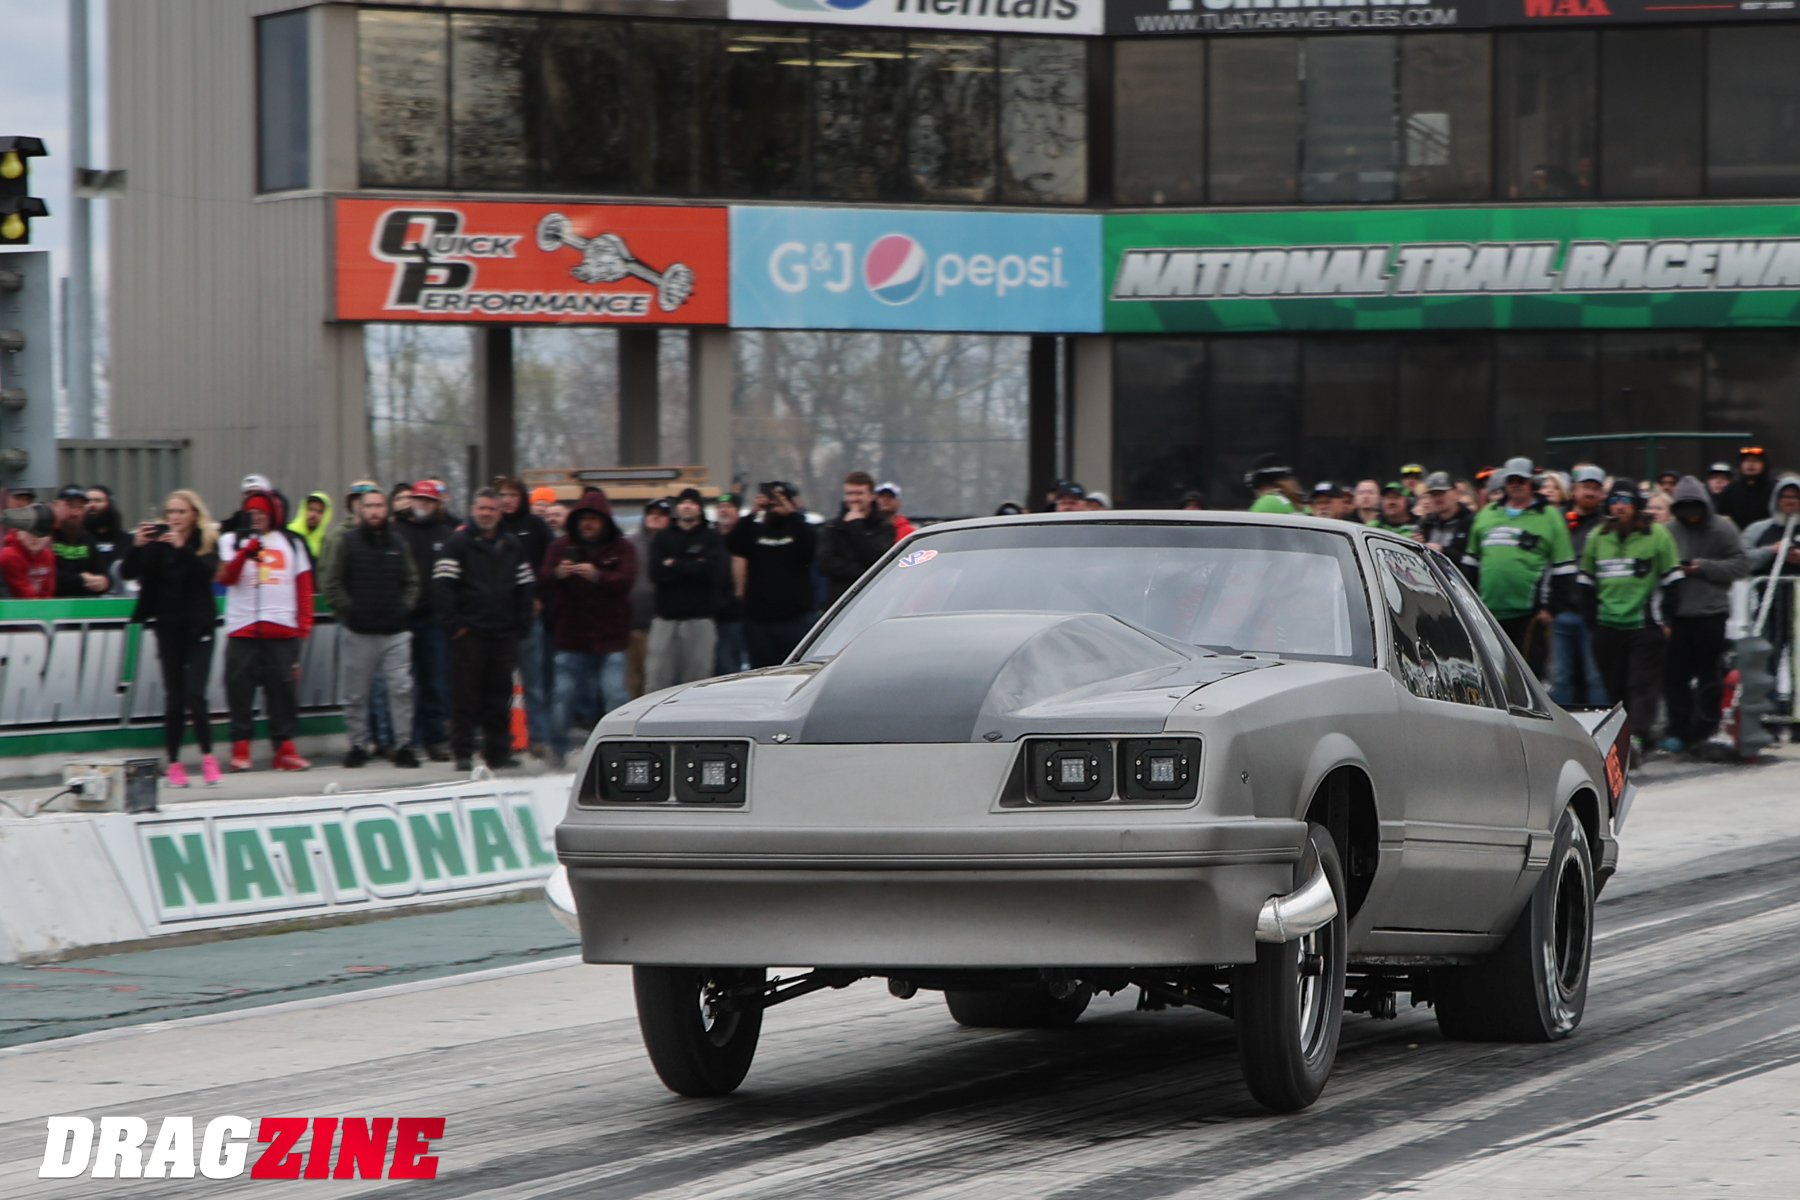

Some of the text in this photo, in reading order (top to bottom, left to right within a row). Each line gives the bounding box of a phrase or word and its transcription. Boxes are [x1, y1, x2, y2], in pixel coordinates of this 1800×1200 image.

[1134, 9, 1457, 31] WWW.TUATARAVEHICLES.COM
[371, 207, 523, 263] QUICK
[383, 258, 651, 316] PERFORMANCE
[768, 241, 1068, 297] G&J pepsi
[1110, 246, 1393, 300] NATIONAL
[1393, 241, 1561, 296] TRAIL
[148, 803, 557, 908] NATIONAL
